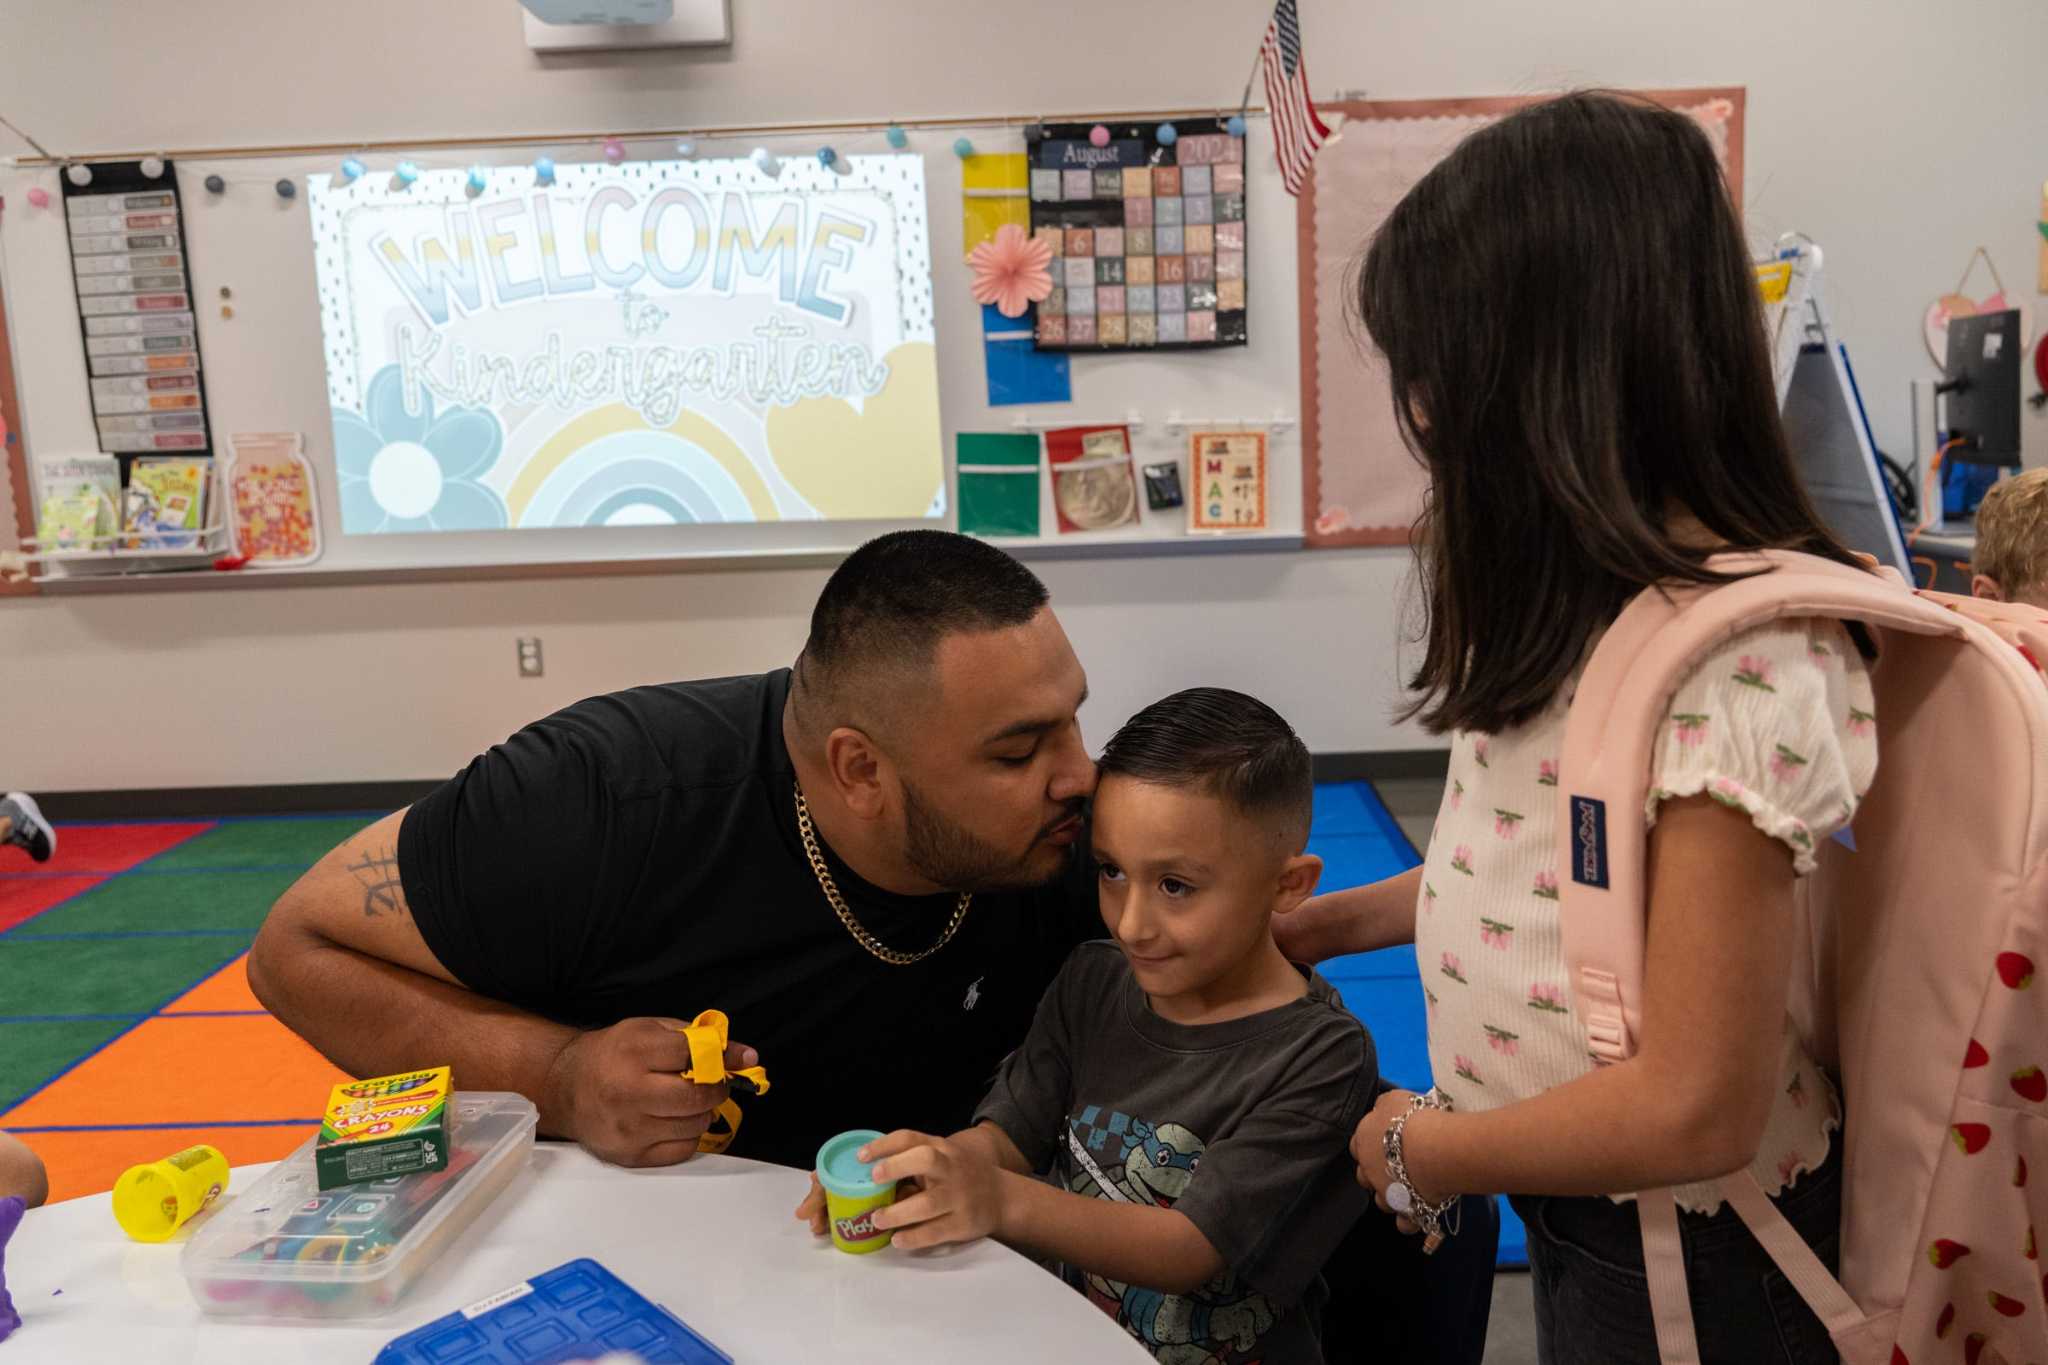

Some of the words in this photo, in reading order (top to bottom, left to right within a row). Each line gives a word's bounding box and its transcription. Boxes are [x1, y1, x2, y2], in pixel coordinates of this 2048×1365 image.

[1063, 142, 1119, 168] August
[1186, 138, 1236, 162] 2024
[1073, 235, 1085, 251] 6
[1135, 233, 1145, 249] 8
[1164, 232, 1176, 249] 9
[372, 183, 874, 327] WELCOME
[1103, 262, 1122, 281] 14
[1162, 261, 1182, 280] 16
[1191, 260, 1210, 278] 17
[617, 288, 671, 336] to
[399, 314, 887, 428] Kindergarten
[1207, 459, 1222, 475] M
[1207, 481, 1223, 499] A
[1208, 503, 1221, 518] C
[333, 1105, 429, 1128] CRAYONS
[368, 1123, 391, 1134] 24
